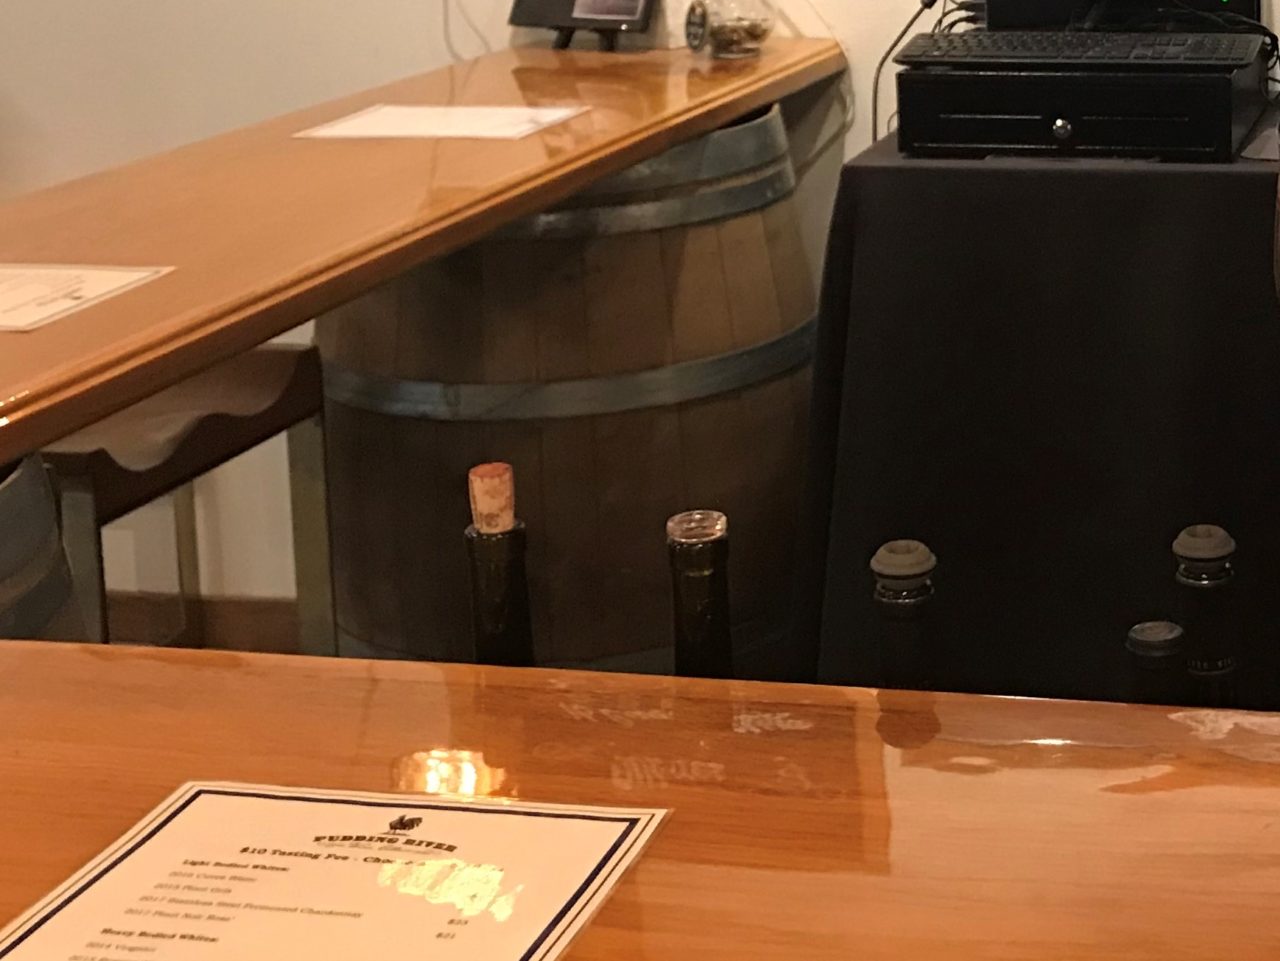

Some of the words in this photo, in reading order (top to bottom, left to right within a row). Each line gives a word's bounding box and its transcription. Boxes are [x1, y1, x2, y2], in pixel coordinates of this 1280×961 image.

[313, 835, 397, 844] PUDDING
[402, 838, 458, 852] RIVER
[240, 847, 267, 855] $10
[271, 848, 321, 860] Tasting
[325, 853, 350, 861] Fee
